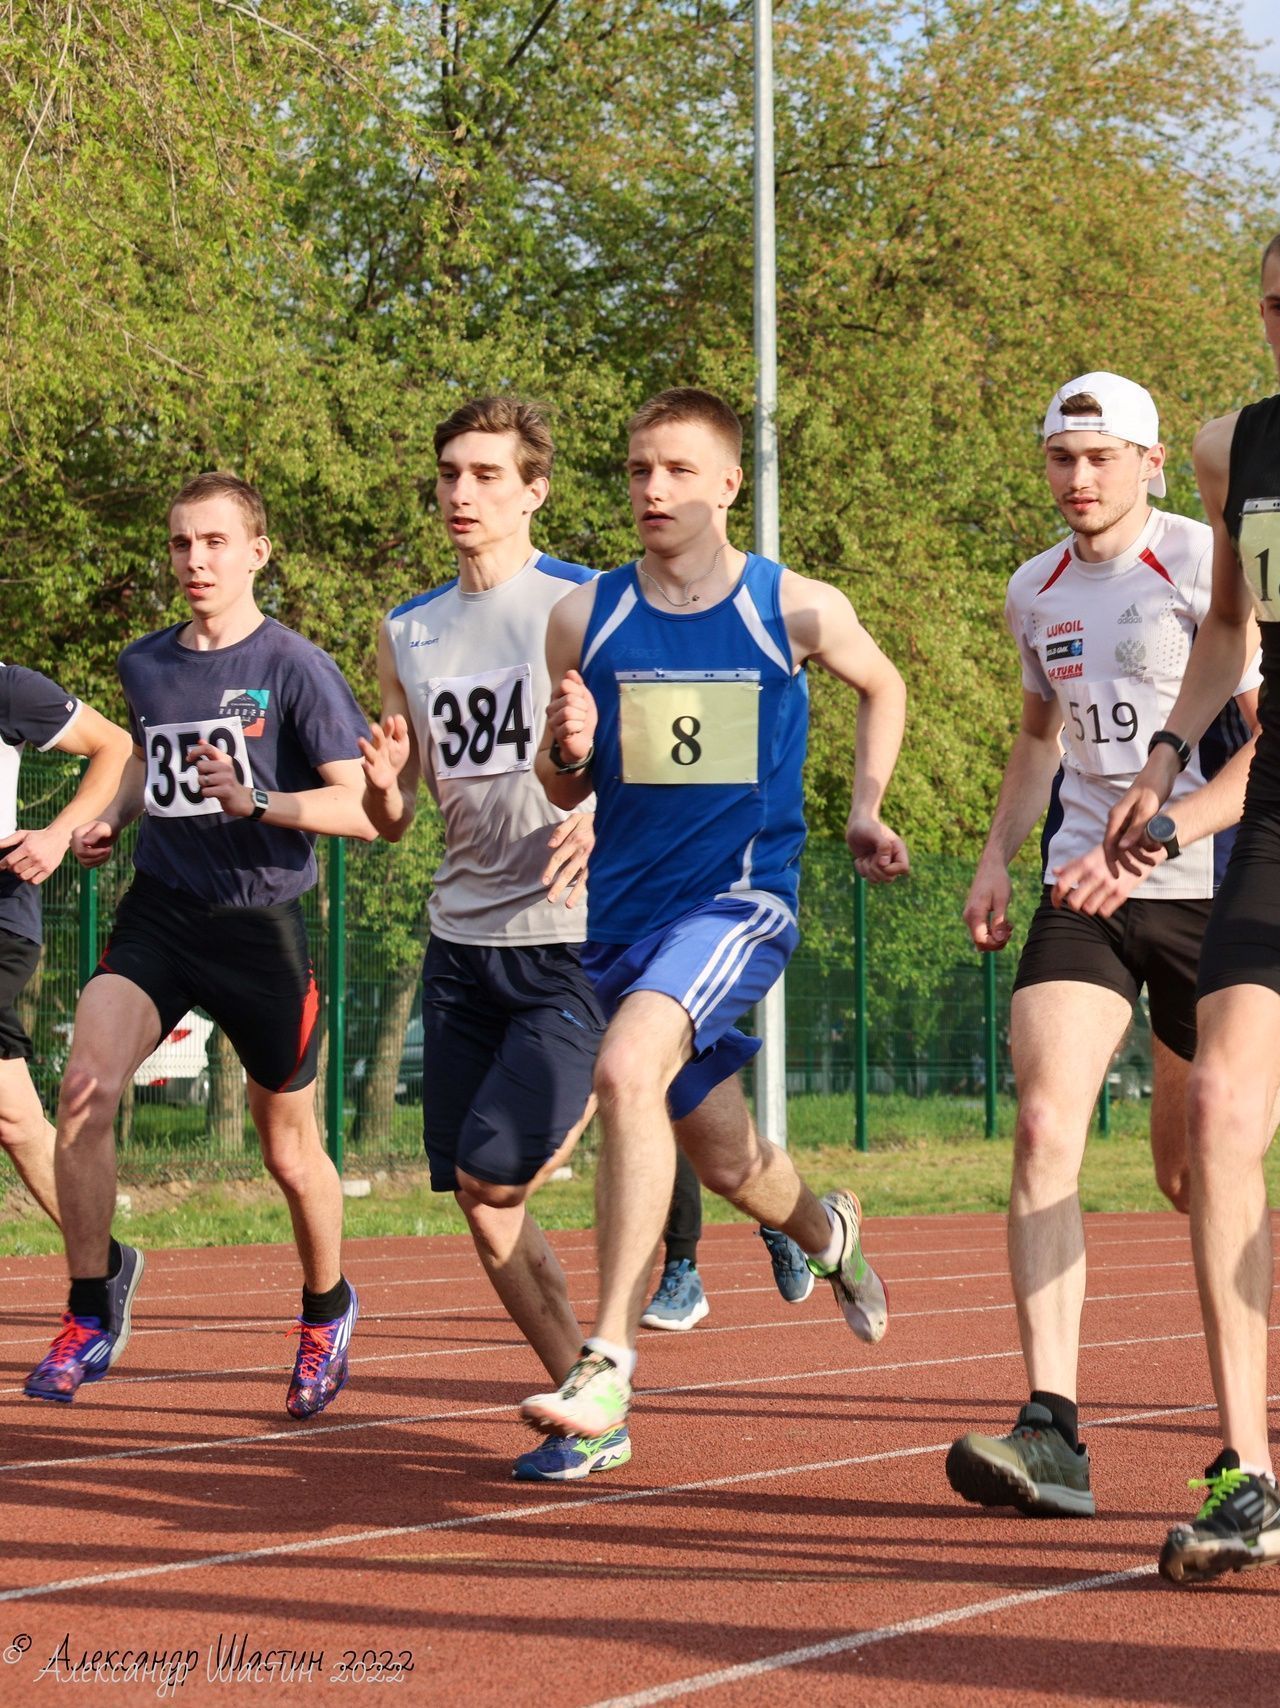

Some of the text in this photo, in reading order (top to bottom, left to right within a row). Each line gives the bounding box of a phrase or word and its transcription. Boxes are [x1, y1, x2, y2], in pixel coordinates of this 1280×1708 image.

[1046, 620, 1084, 639] LUKOIL
[431, 678, 532, 769] 384
[670, 714, 702, 766] 8
[1068, 700, 1140, 744] 519
